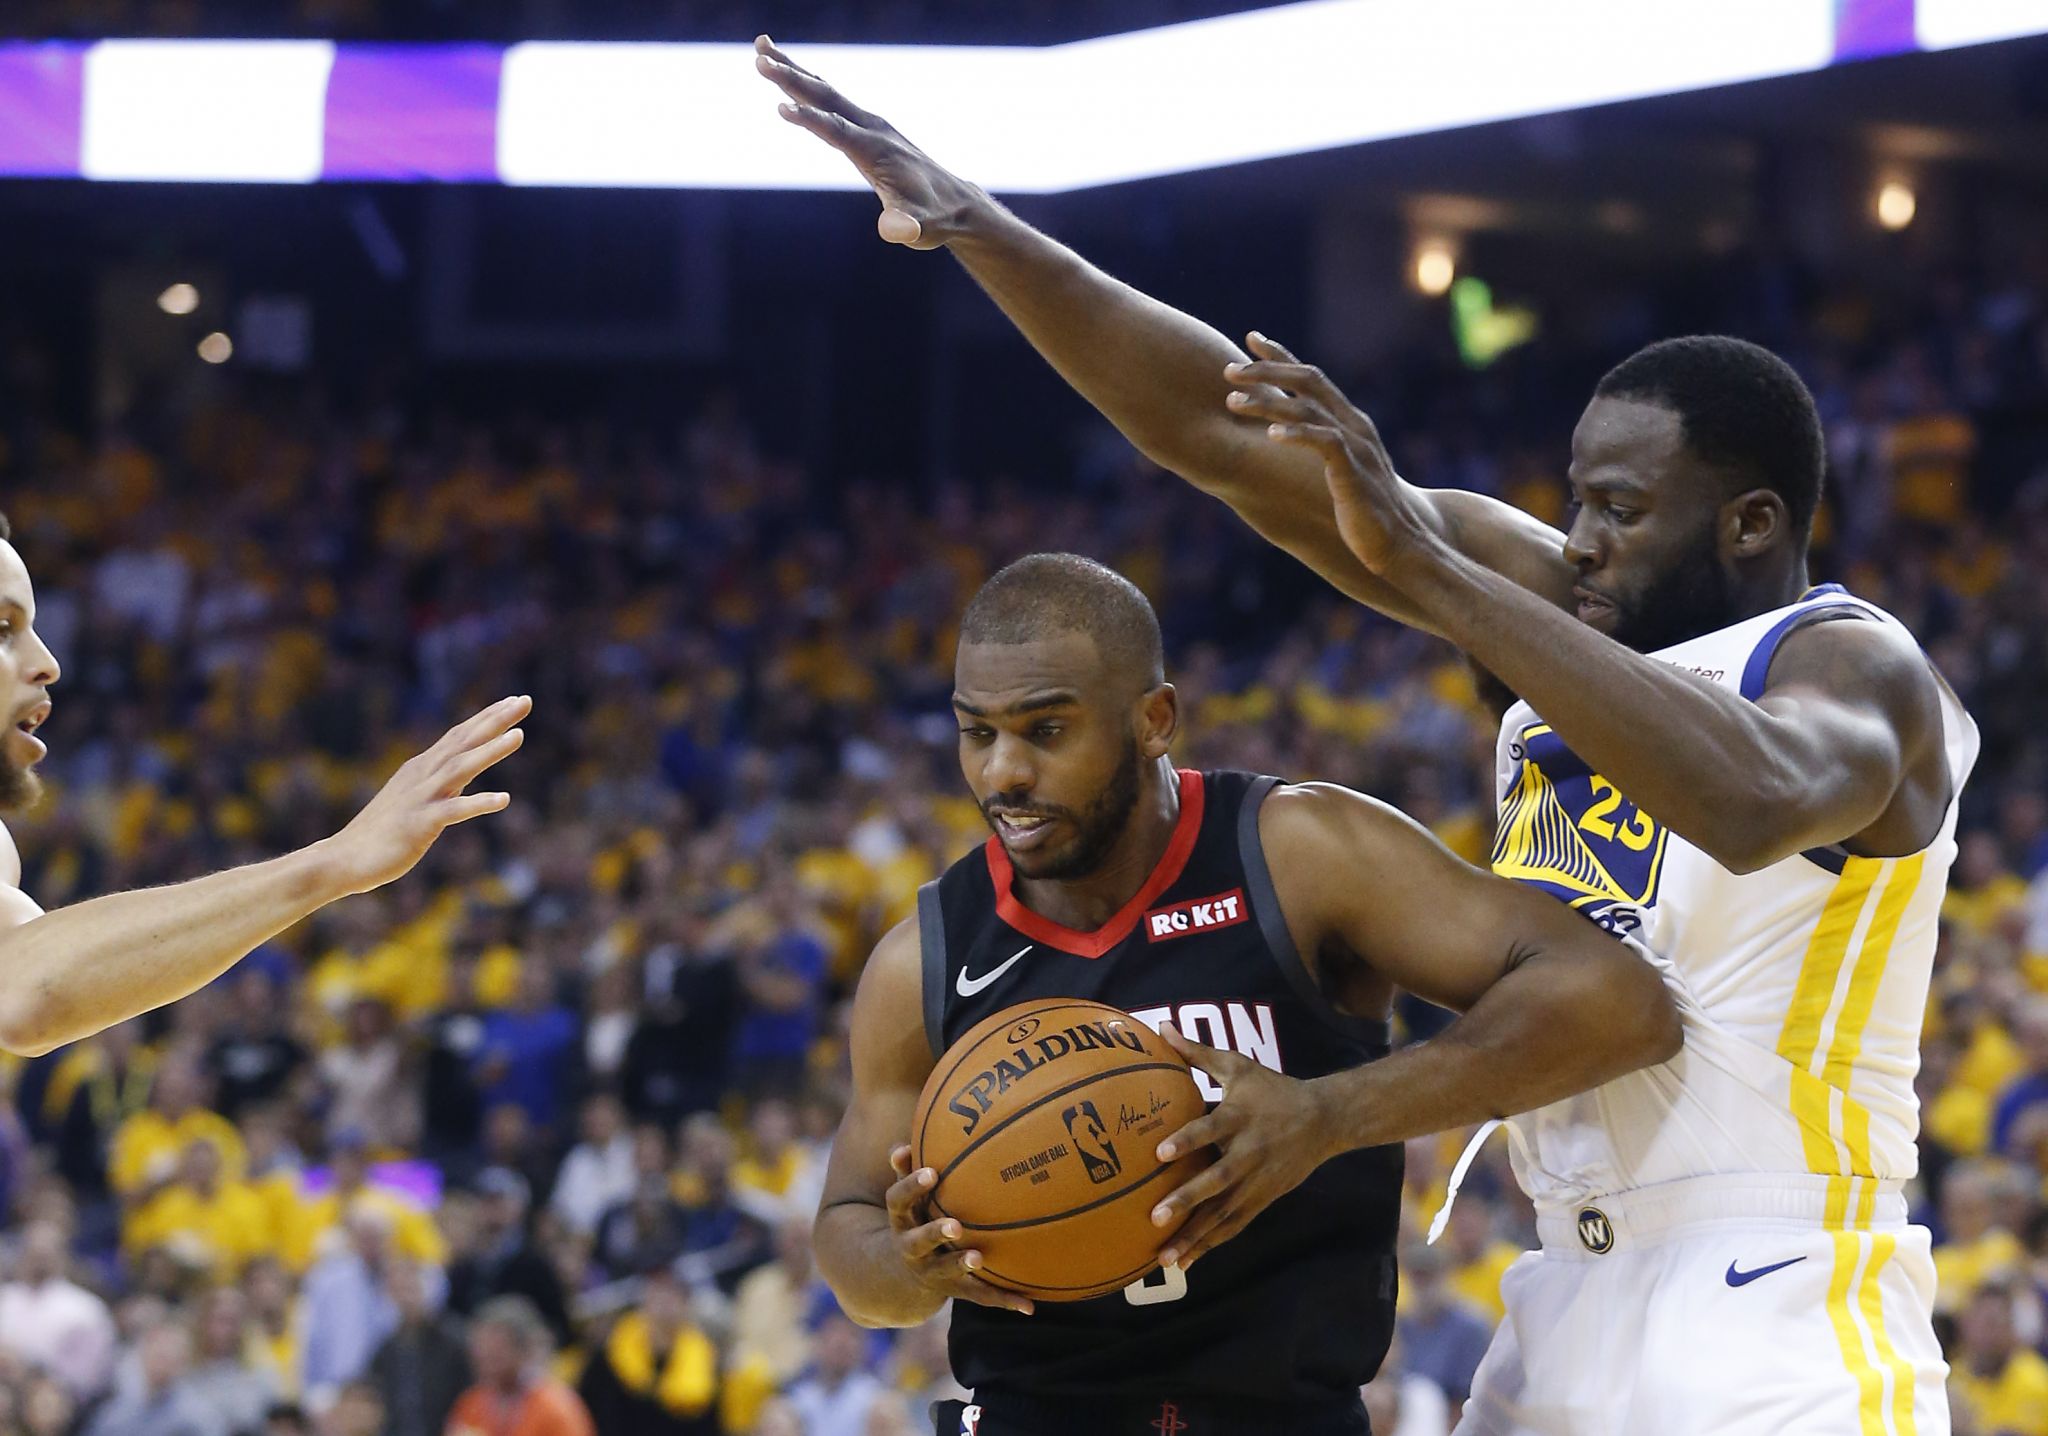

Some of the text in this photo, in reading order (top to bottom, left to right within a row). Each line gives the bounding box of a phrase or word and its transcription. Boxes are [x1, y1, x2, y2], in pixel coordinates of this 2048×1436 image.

[1577, 773, 1655, 852] 23
[948, 1019, 1146, 1136] SPALDING
[1000, 1144, 1070, 1183] OFFICIAL GAME BALL
